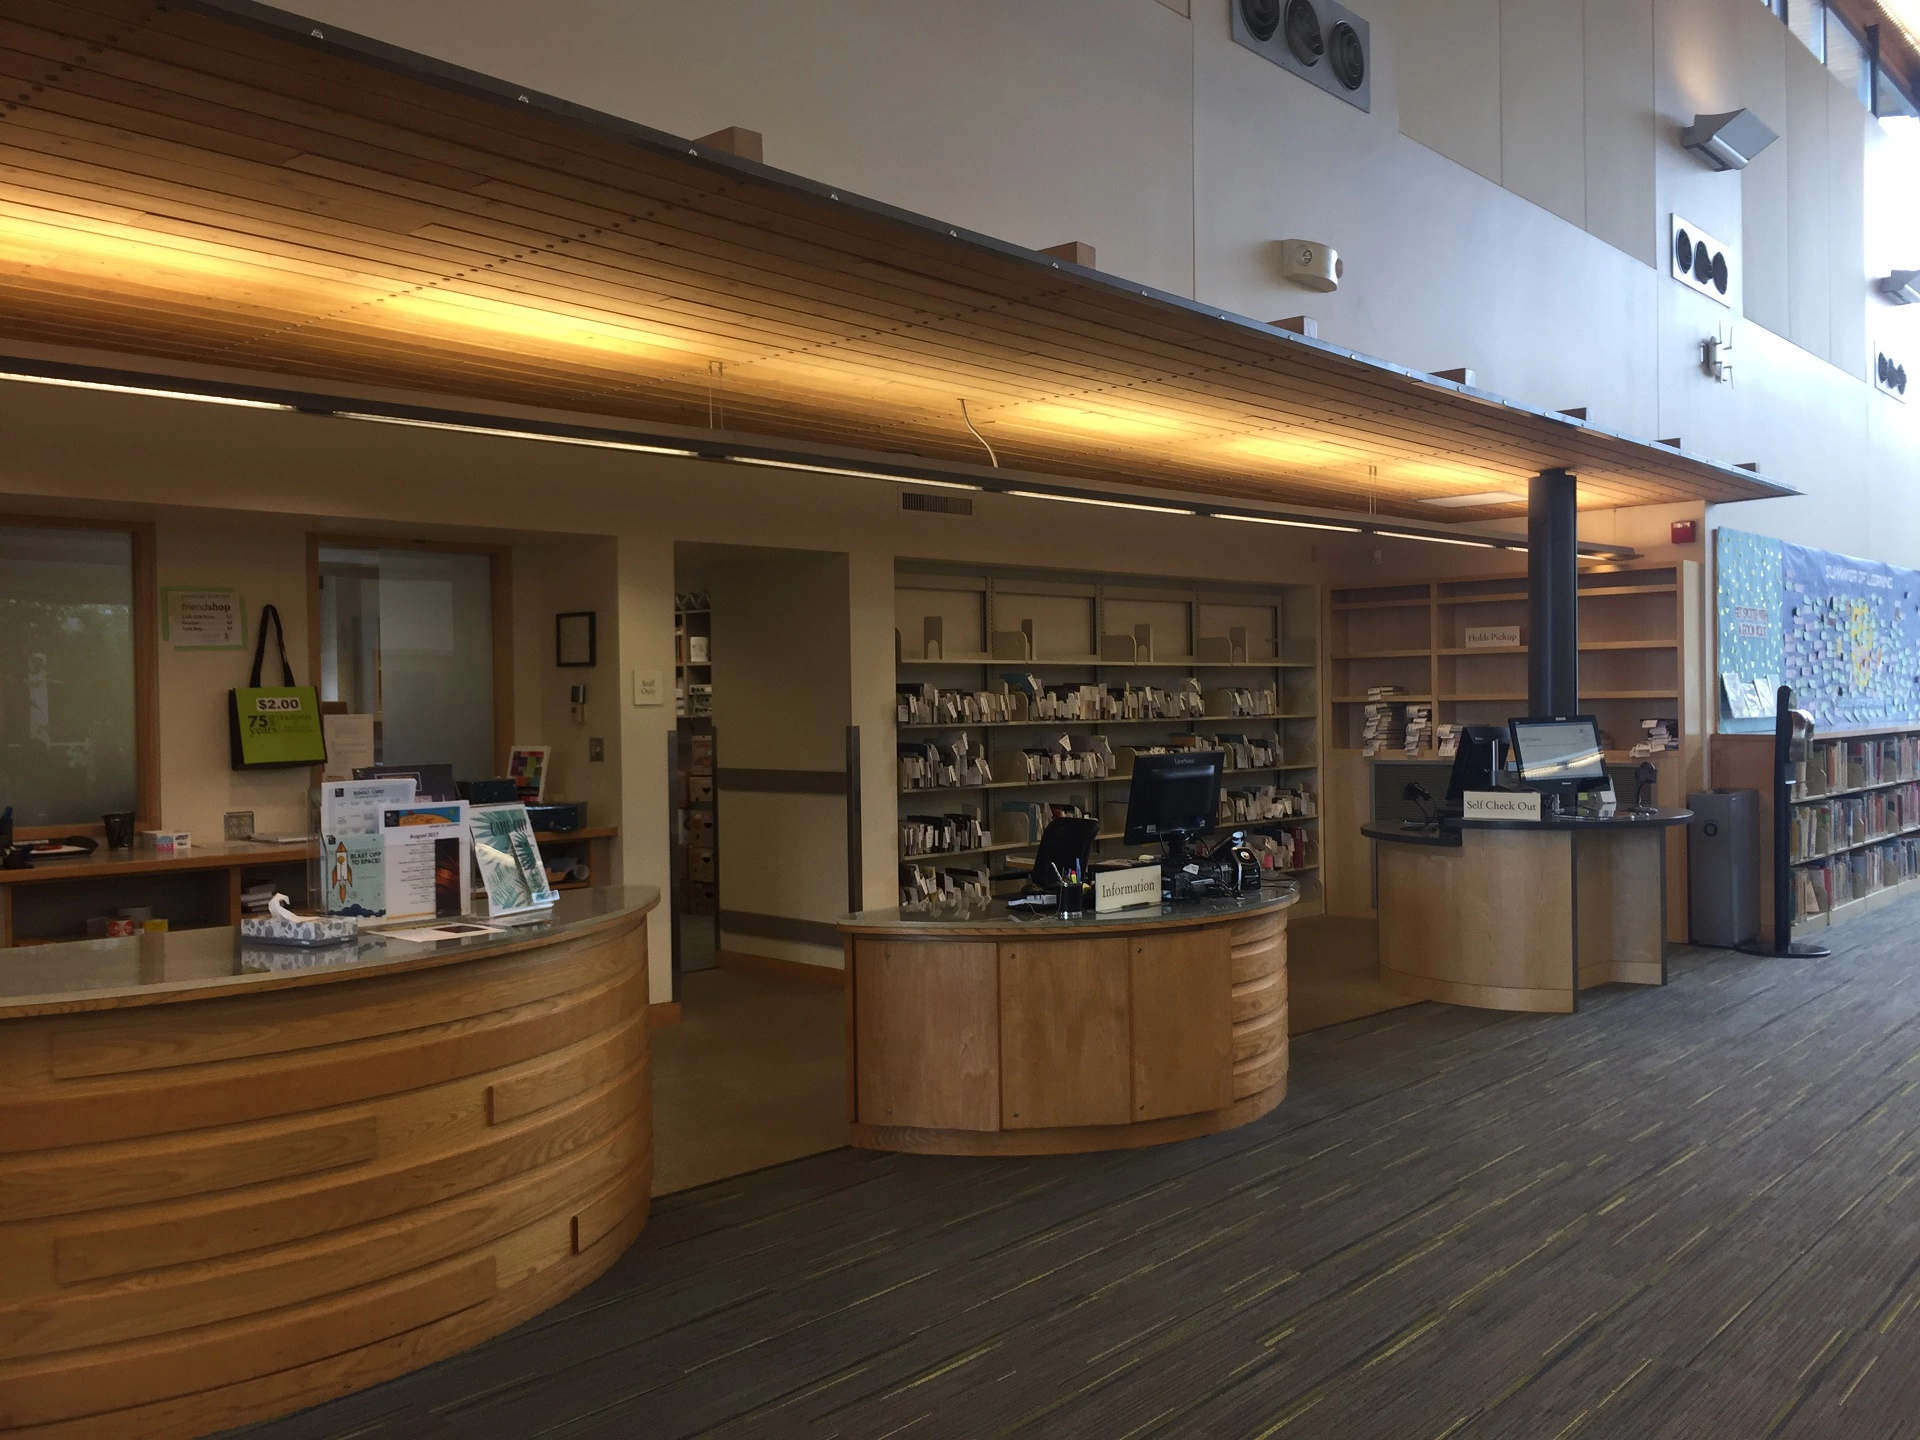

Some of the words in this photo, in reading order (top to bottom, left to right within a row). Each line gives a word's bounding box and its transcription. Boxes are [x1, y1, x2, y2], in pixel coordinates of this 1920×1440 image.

[1468, 633, 1489, 642] Holds
[1491, 632, 1517, 642] Pickup
[258, 699, 299, 710] $2.00
[247, 715, 268, 728] 75
[1467, 800, 1483, 809] Self
[1485, 800, 1515, 810] Check
[1517, 801, 1536, 811] Out
[1102, 878, 1155, 898] Information
